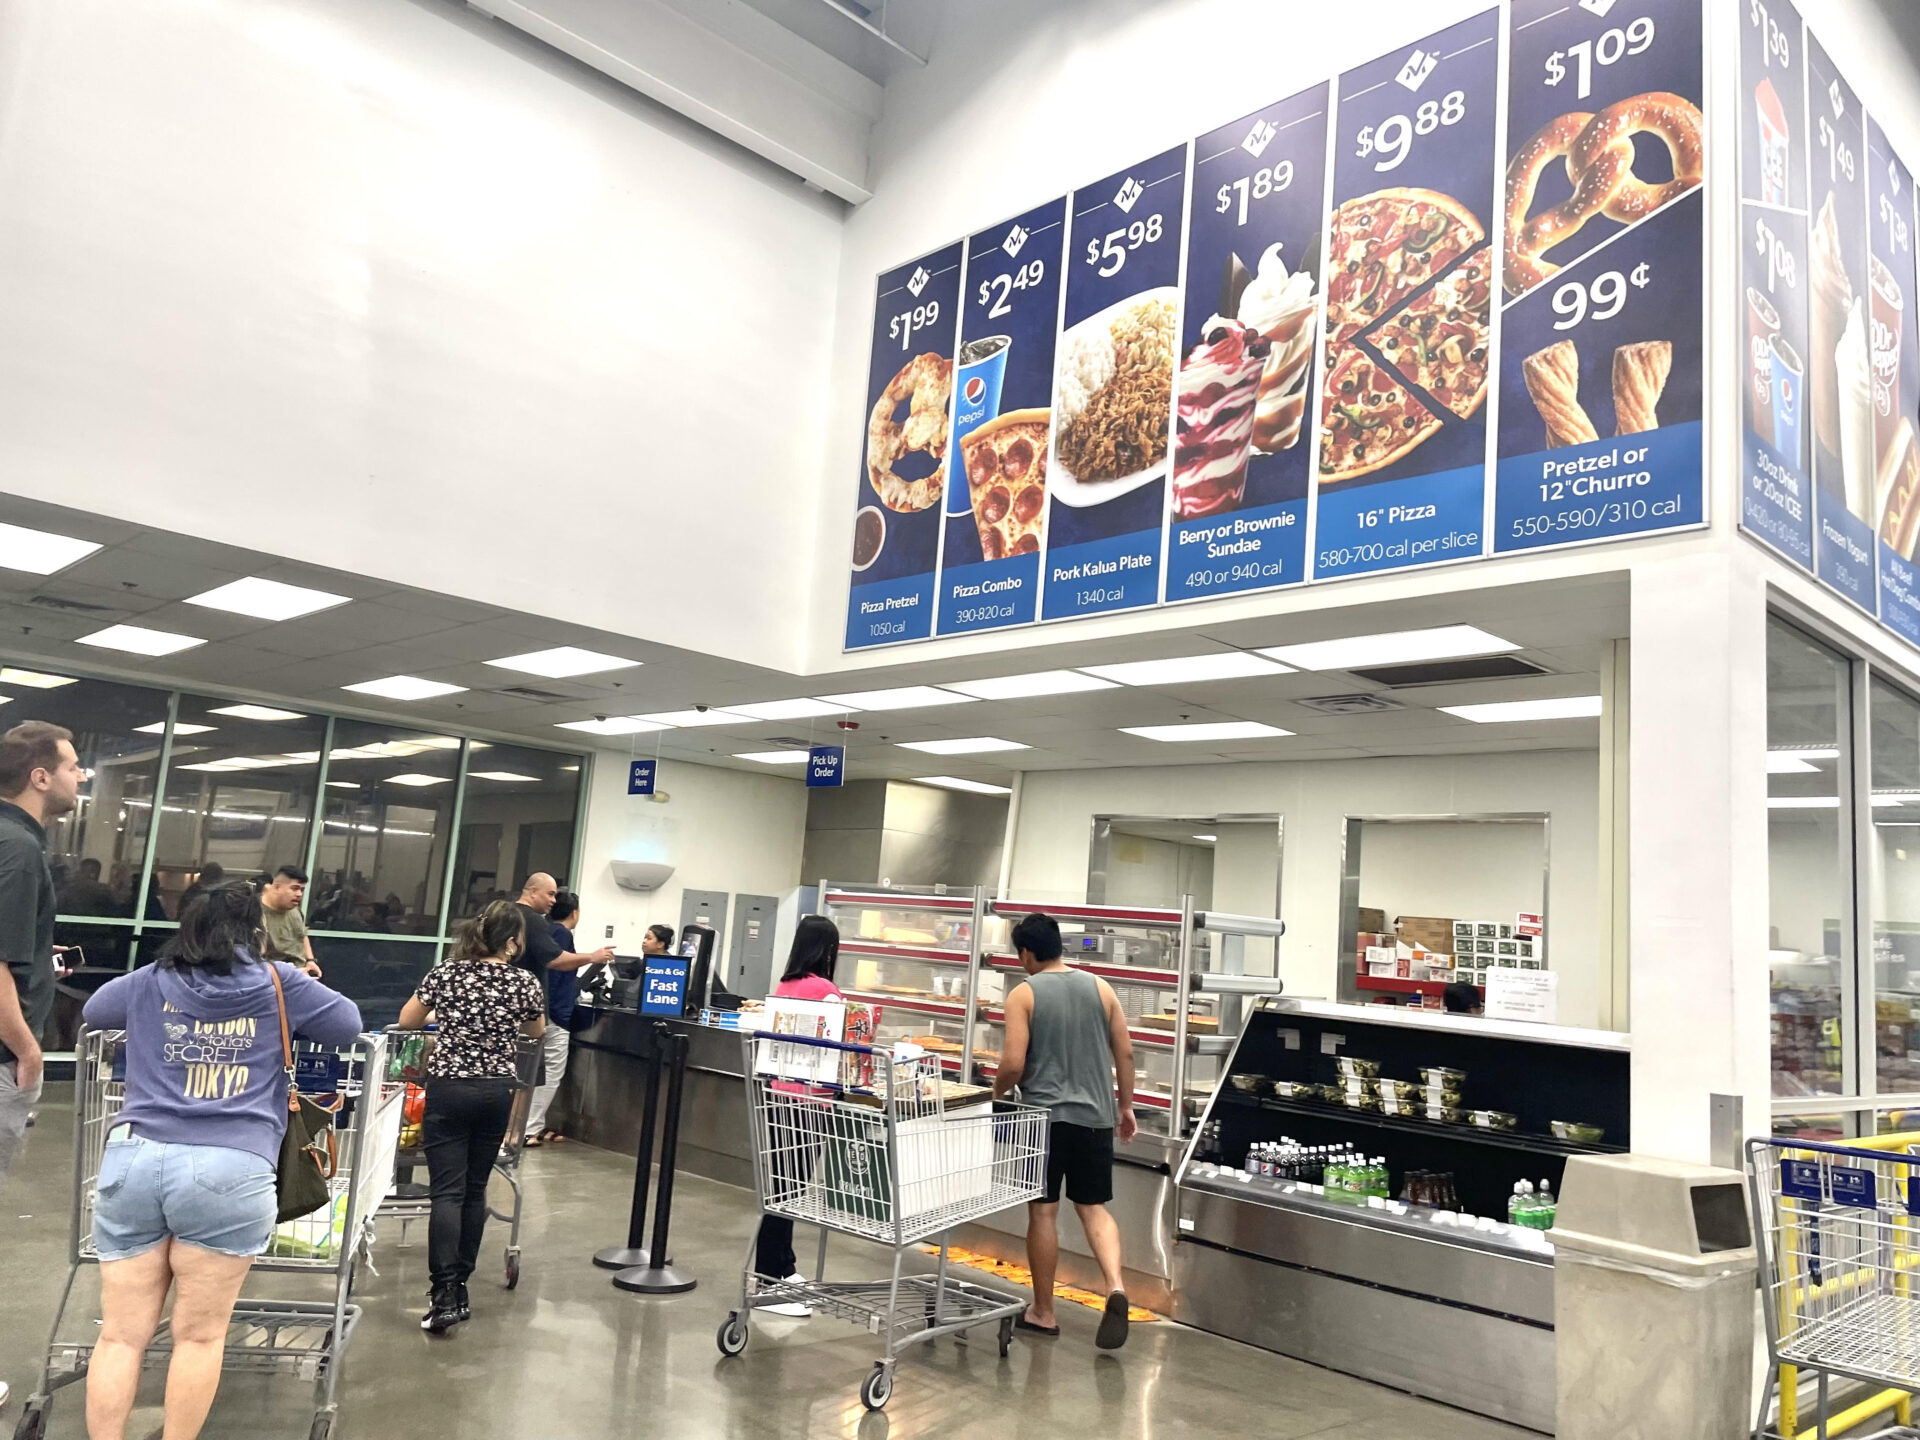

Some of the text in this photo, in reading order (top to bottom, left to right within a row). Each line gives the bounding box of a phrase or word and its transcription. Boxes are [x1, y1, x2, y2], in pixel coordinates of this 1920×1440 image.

[1544, 17, 1655, 99] $109
[1355, 90, 1465, 172] $988
[1216, 160, 1294, 226] $189
[1086, 213, 1163, 278] $598
[978, 260, 1044, 319] $249
[889, 301, 939, 351] $199
[958, 405, 985, 427] pepsi
[1543, 447, 1648, 480] Pretzel or
[1753, 476, 1762, 491] or
[1764, 478, 1784, 508] 20oz
[1779, 466, 1799, 496] Drink
[1357, 502, 1436, 528] 16" Pizza
[1511, 494, 1681, 537] 550-590/310 cal
[1180, 511, 1295, 546] Berry or Brownie
[1208, 536, 1261, 558] Sundae
[1318, 530, 1478, 568] 580-700 cal per slice
[1823, 518, 1868, 566] Frozen Yogurt
[1054, 552, 1152, 582] Pork Kalua Plate
[1186, 559, 1282, 588] 490 or 940 cal
[953, 576, 1022, 598] Pizza Combo
[1076, 586, 1124, 605] 1340 cal
[861, 594, 918, 614] Pizza Pretzel
[956, 603, 1014, 624] 390-820 cal
[870, 620, 905, 637] 1050 cal
[635, 768, 650, 776] Order
[812, 756, 838, 766] Pick Up
[814, 768, 834, 777] Order
[635, 778, 647, 786] Here
[646, 967, 664, 975] Scan
[646, 992, 678, 1005] Lane
[650, 979, 678, 992] Fast
[194, 1017, 257, 1037] LONDON
[164, 1043, 246, 1063] SECRET
[184, 1064, 248, 1098] TOKYO
